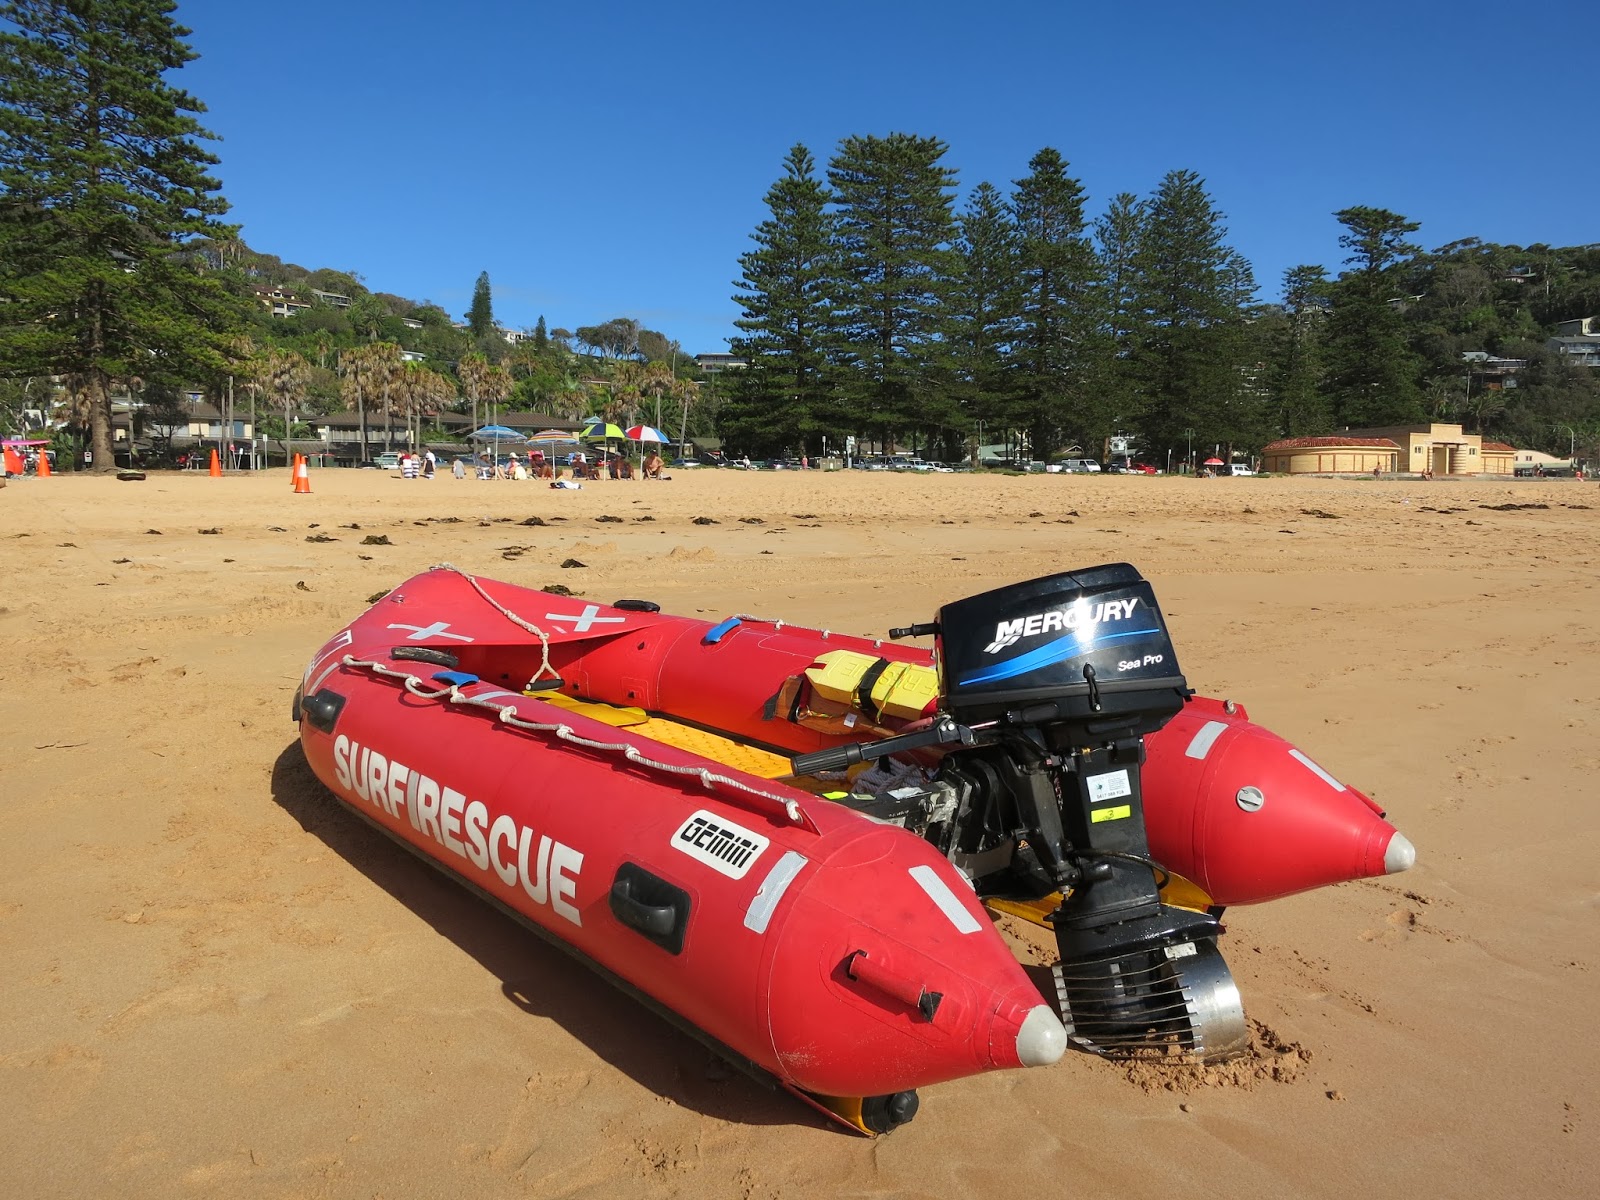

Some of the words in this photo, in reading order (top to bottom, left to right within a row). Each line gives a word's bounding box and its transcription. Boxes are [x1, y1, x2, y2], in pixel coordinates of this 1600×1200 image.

[994, 598, 1138, 643] MERCURY
[1117, 660, 1141, 672] Sea
[1143, 654, 1163, 667] Pro
